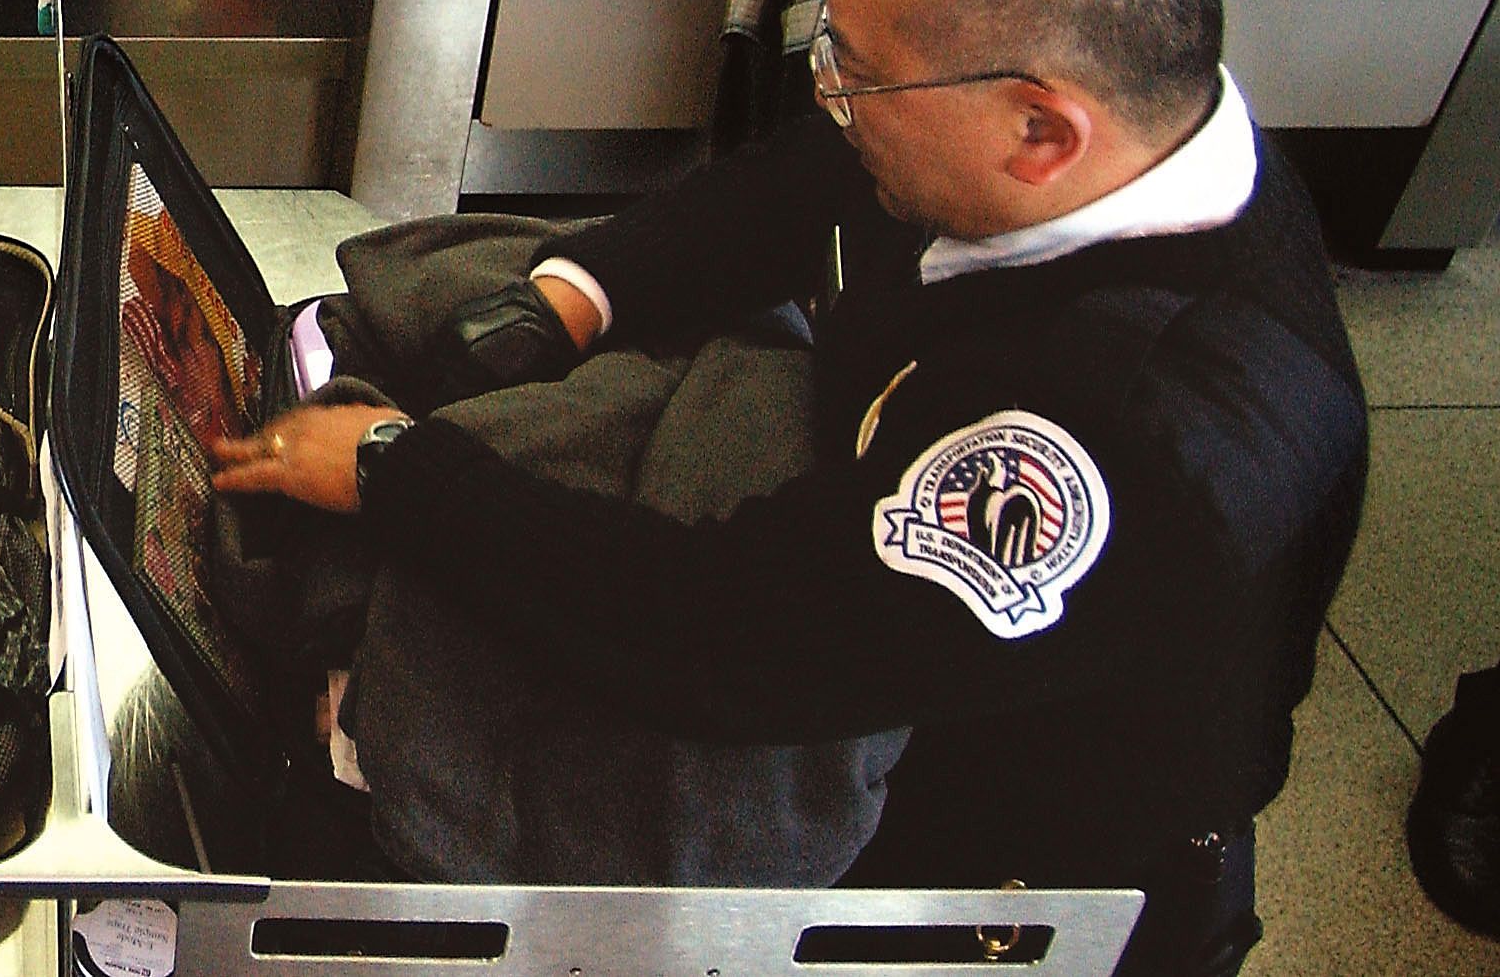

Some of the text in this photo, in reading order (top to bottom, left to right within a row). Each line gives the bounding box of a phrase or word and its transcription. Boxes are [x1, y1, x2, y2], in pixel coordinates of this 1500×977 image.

[1011, 433, 1067, 470] SECURITY
[919, 543, 998, 599] TRANSPORTATION
[941, 535, 1003, 581] DEPARTMENT
